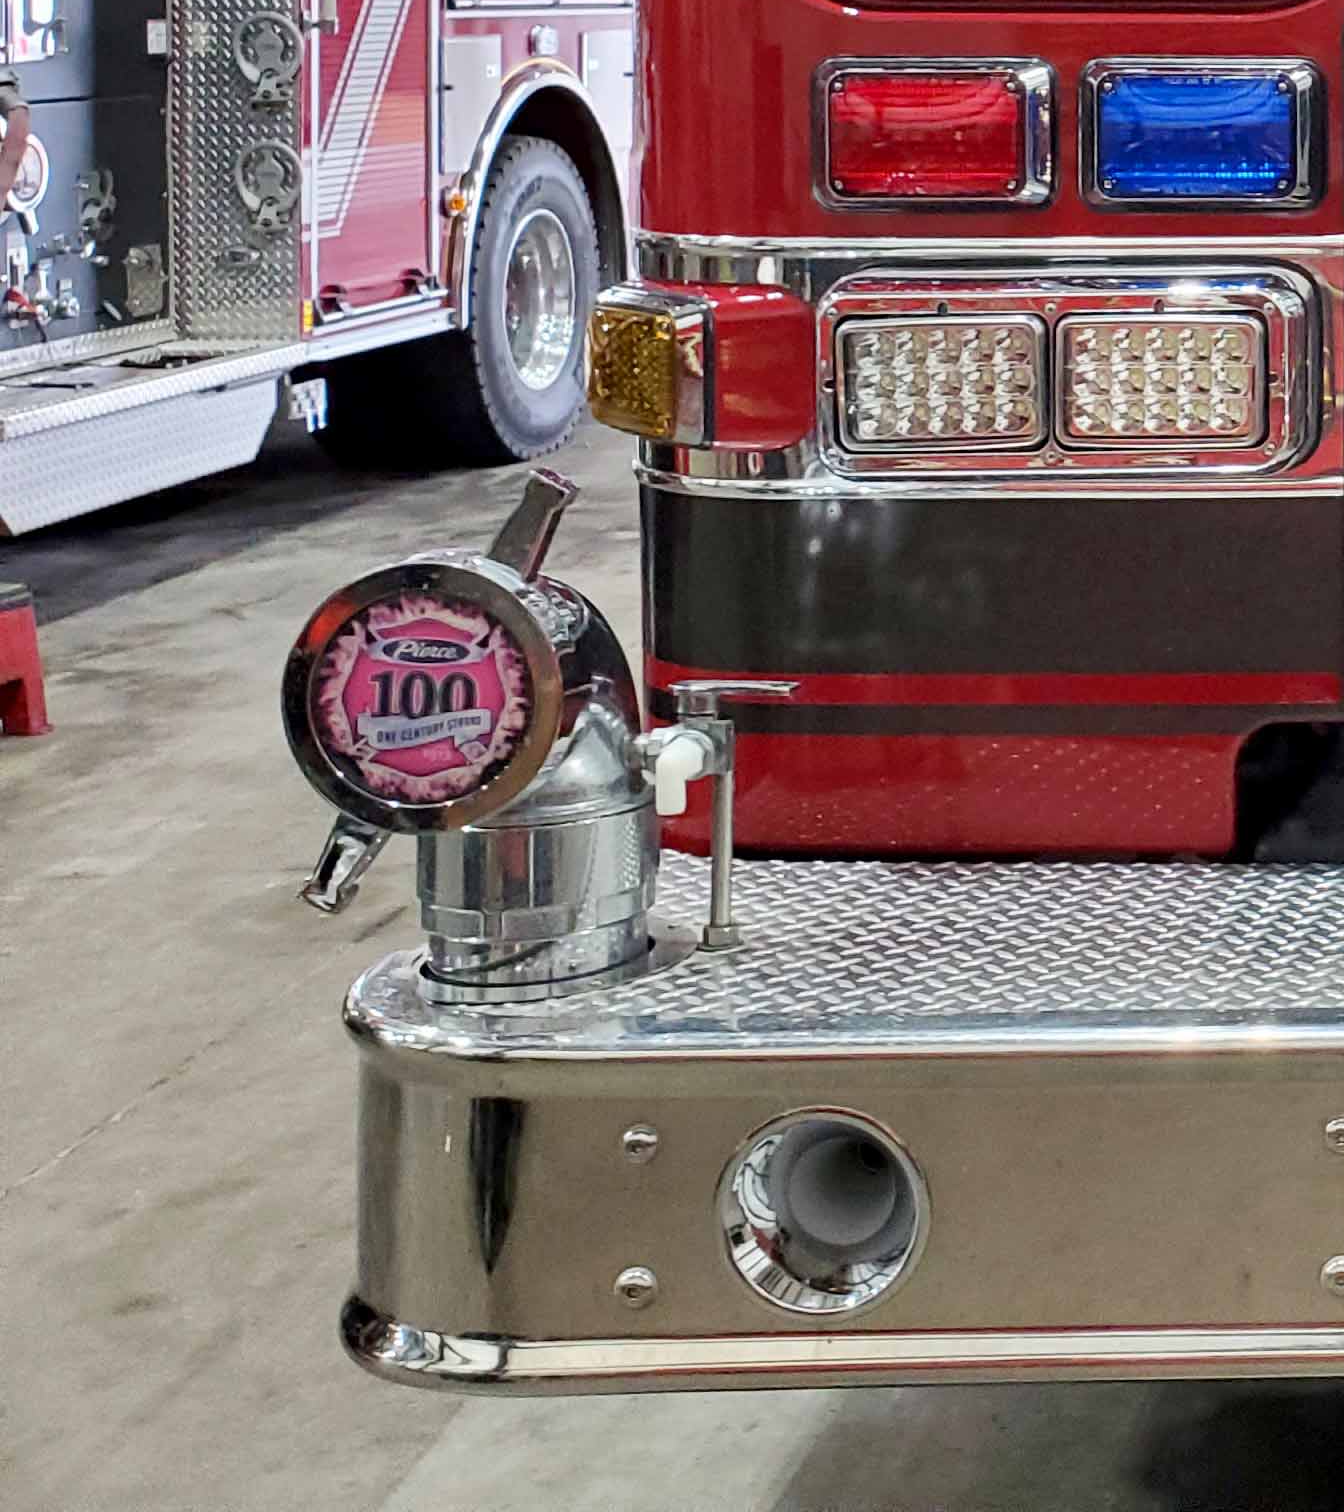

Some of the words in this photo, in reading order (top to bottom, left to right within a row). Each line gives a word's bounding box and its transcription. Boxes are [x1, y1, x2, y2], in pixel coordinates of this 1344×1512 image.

[392, 640, 457, 660] Pierce
[369, 670, 478, 719] 100
[377, 729, 397, 744] ONE
[400, 721, 445, 741] CENTURY
[447, 715, 481, 732] STRONG
